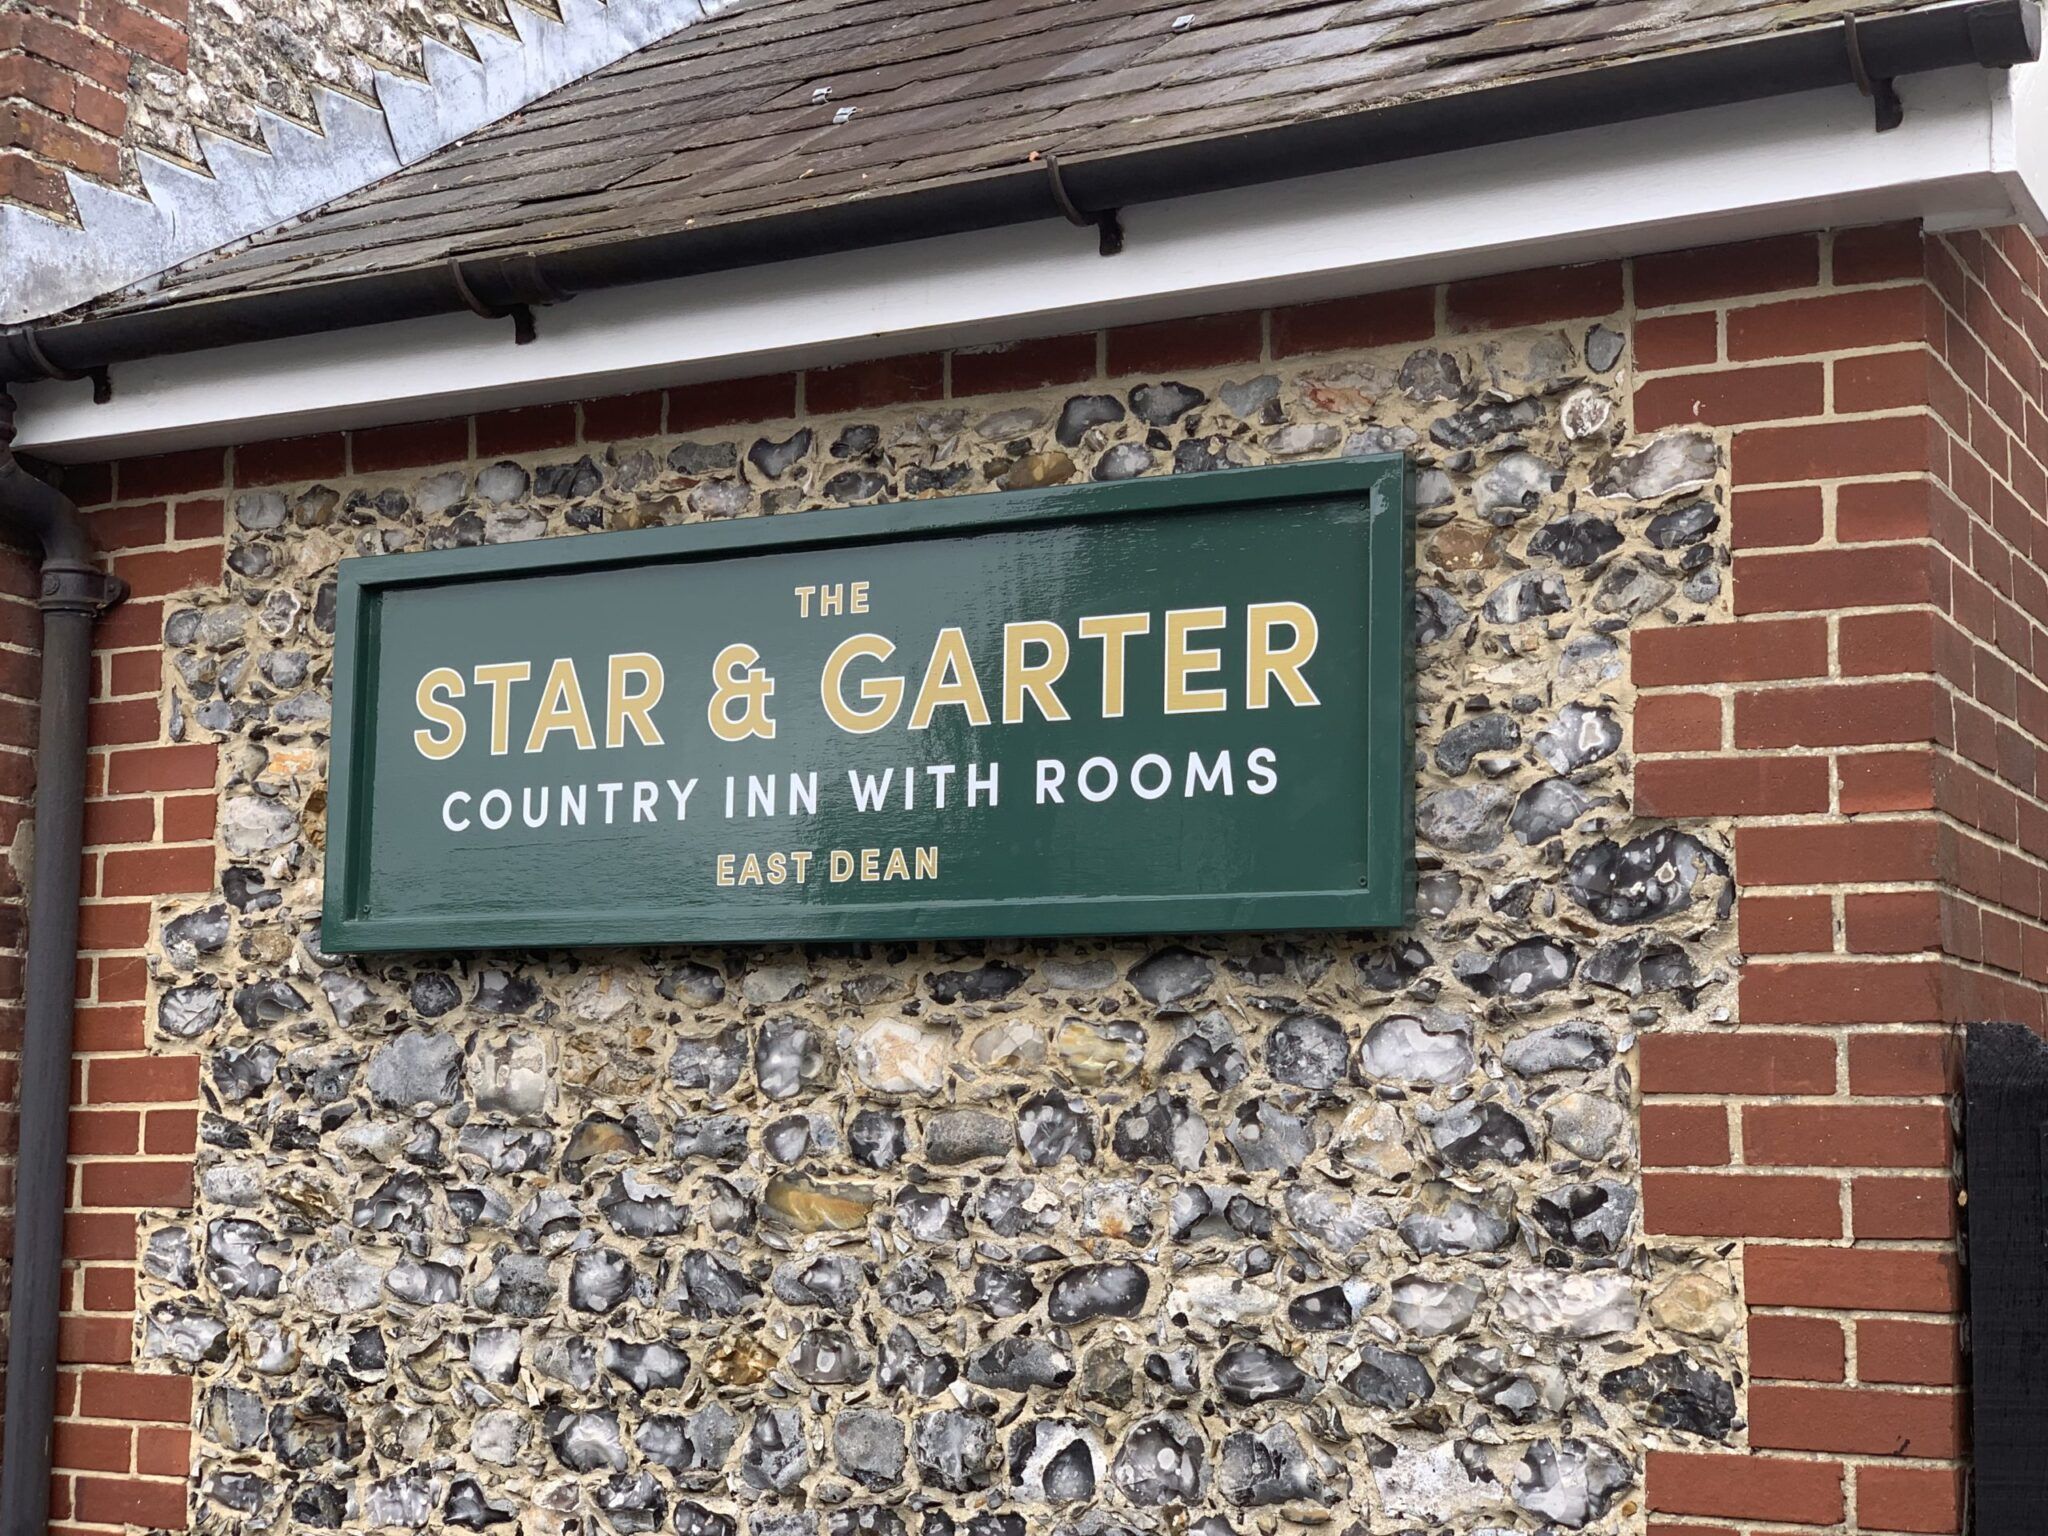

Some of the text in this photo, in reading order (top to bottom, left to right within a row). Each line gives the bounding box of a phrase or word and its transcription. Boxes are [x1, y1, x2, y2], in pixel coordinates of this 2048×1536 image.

[795, 581, 870, 618] THE
[413, 602, 1322, 760] STAR & GARTER
[442, 747, 1278, 831] COUNTRY INN WITH ROOMS
[716, 846, 939, 888] EAST DEAN
